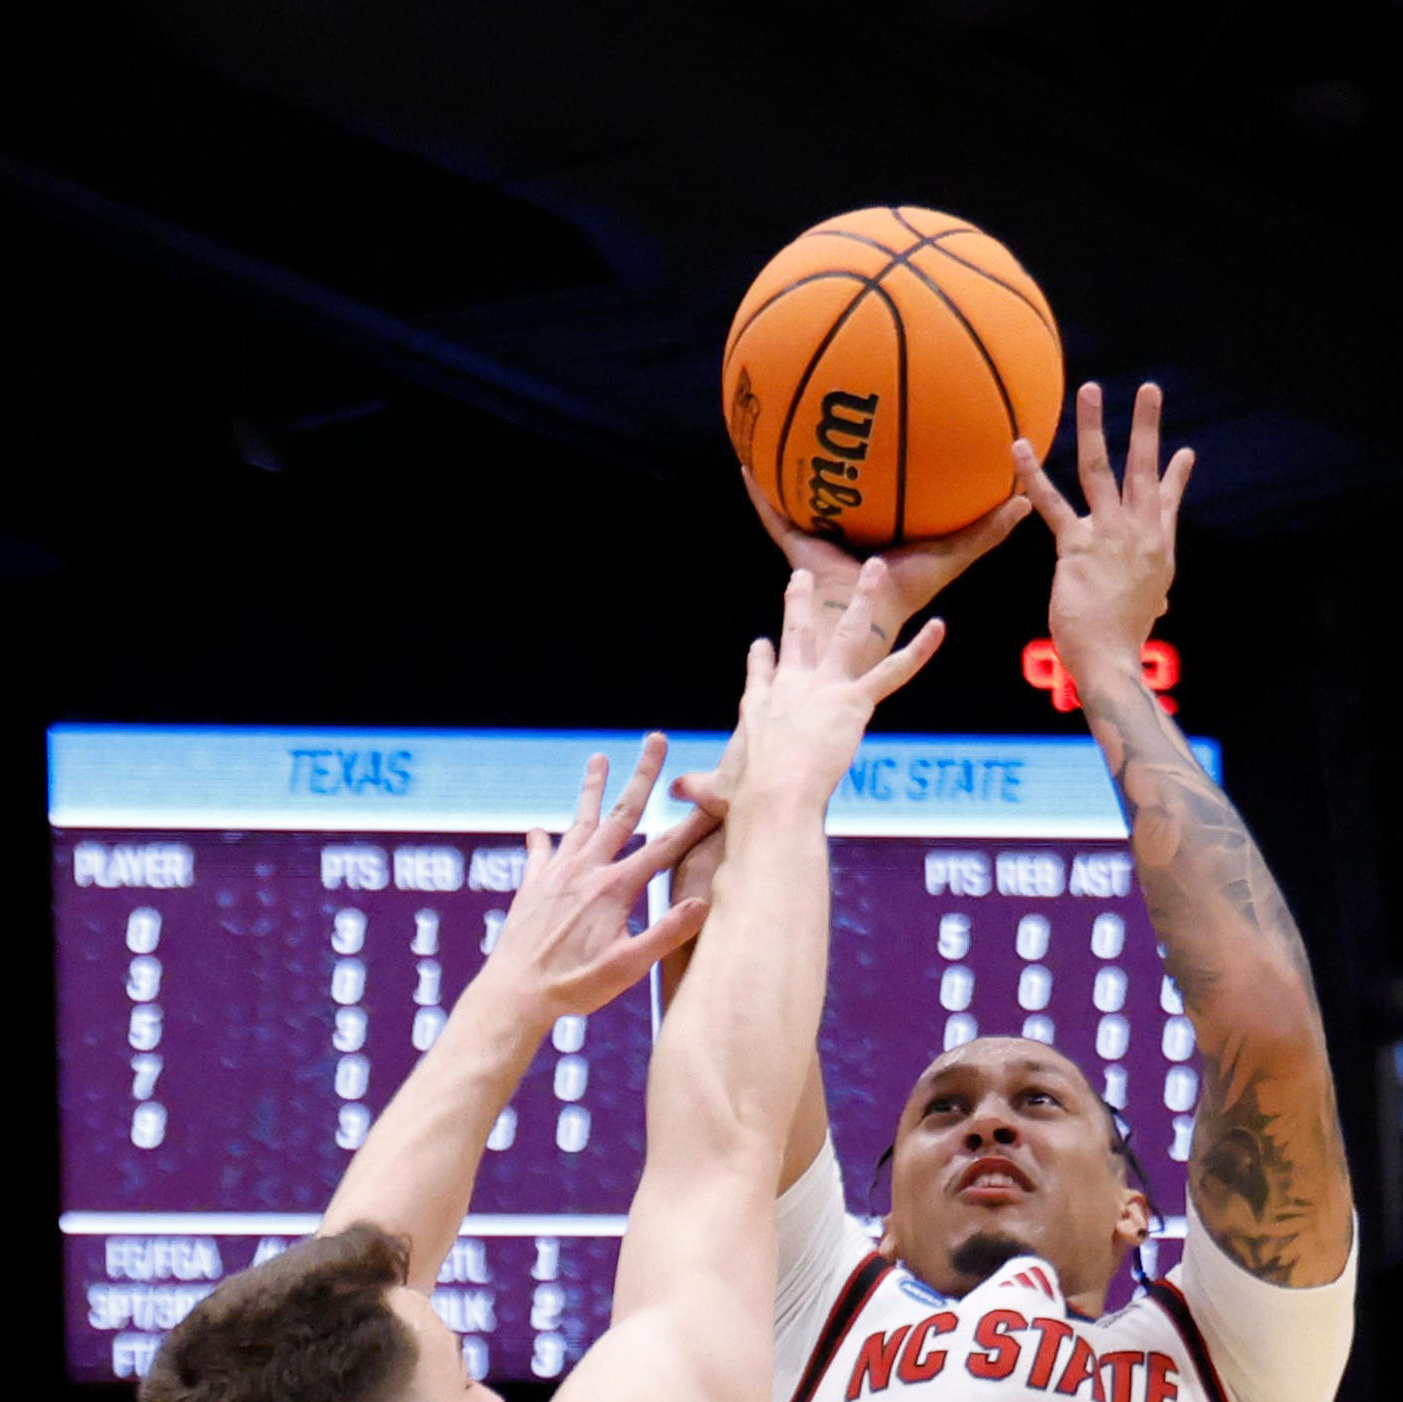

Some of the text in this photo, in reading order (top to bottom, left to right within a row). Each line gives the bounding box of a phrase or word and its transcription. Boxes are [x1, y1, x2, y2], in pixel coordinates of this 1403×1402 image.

[287, 748, 413, 796] TEXAS
[905, 757, 1025, 803] STATE
[73, 843, 527, 892] PLAYER PTS REB AST
[924, 853, 1132, 898] PTS REB AST
[126, 908, 162, 954] 0
[330, 908, 367, 955] 3
[410, 909, 439, 956] 1
[937, 913, 1125, 961] 5 0 0
[126, 955, 442, 1008] 3 0 1
[939, 966, 975, 1012] 0
[1017, 965, 1052, 1011] 0
[1093, 967, 1127, 1013] 0
[128, 1004, 162, 1051] 5
[332, 1006, 368, 1053] 3
[1095, 1009, 1130, 1060] 0
[131, 1053, 588, 1102] 7 0 0
[1163, 1066, 1198, 1112] 0
[556, 1105, 591, 1153] 0
[530, 1236, 560, 1281] 1
[530, 1283, 568, 1332] 2
[530, 1330, 568, 1378] 3
